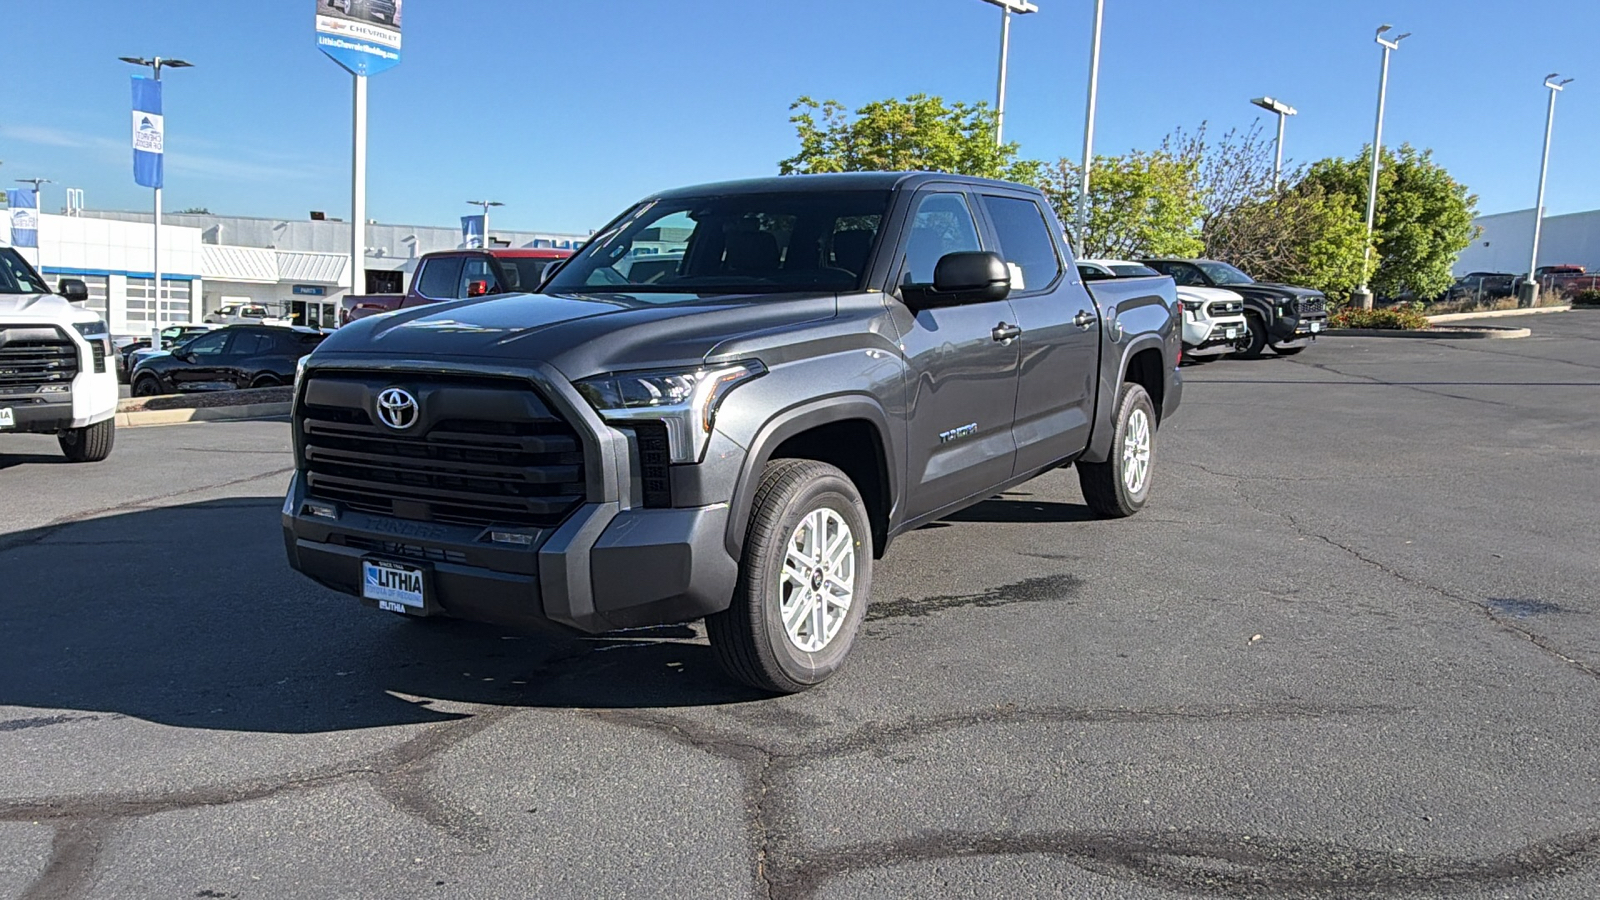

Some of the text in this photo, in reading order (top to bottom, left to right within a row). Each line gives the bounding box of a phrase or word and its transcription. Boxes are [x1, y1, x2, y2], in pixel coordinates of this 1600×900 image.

[349, 25, 397, 42] CHEVROLET
[378, 568, 422, 594] LITHIA
[386, 599, 406, 614] LITHIA
